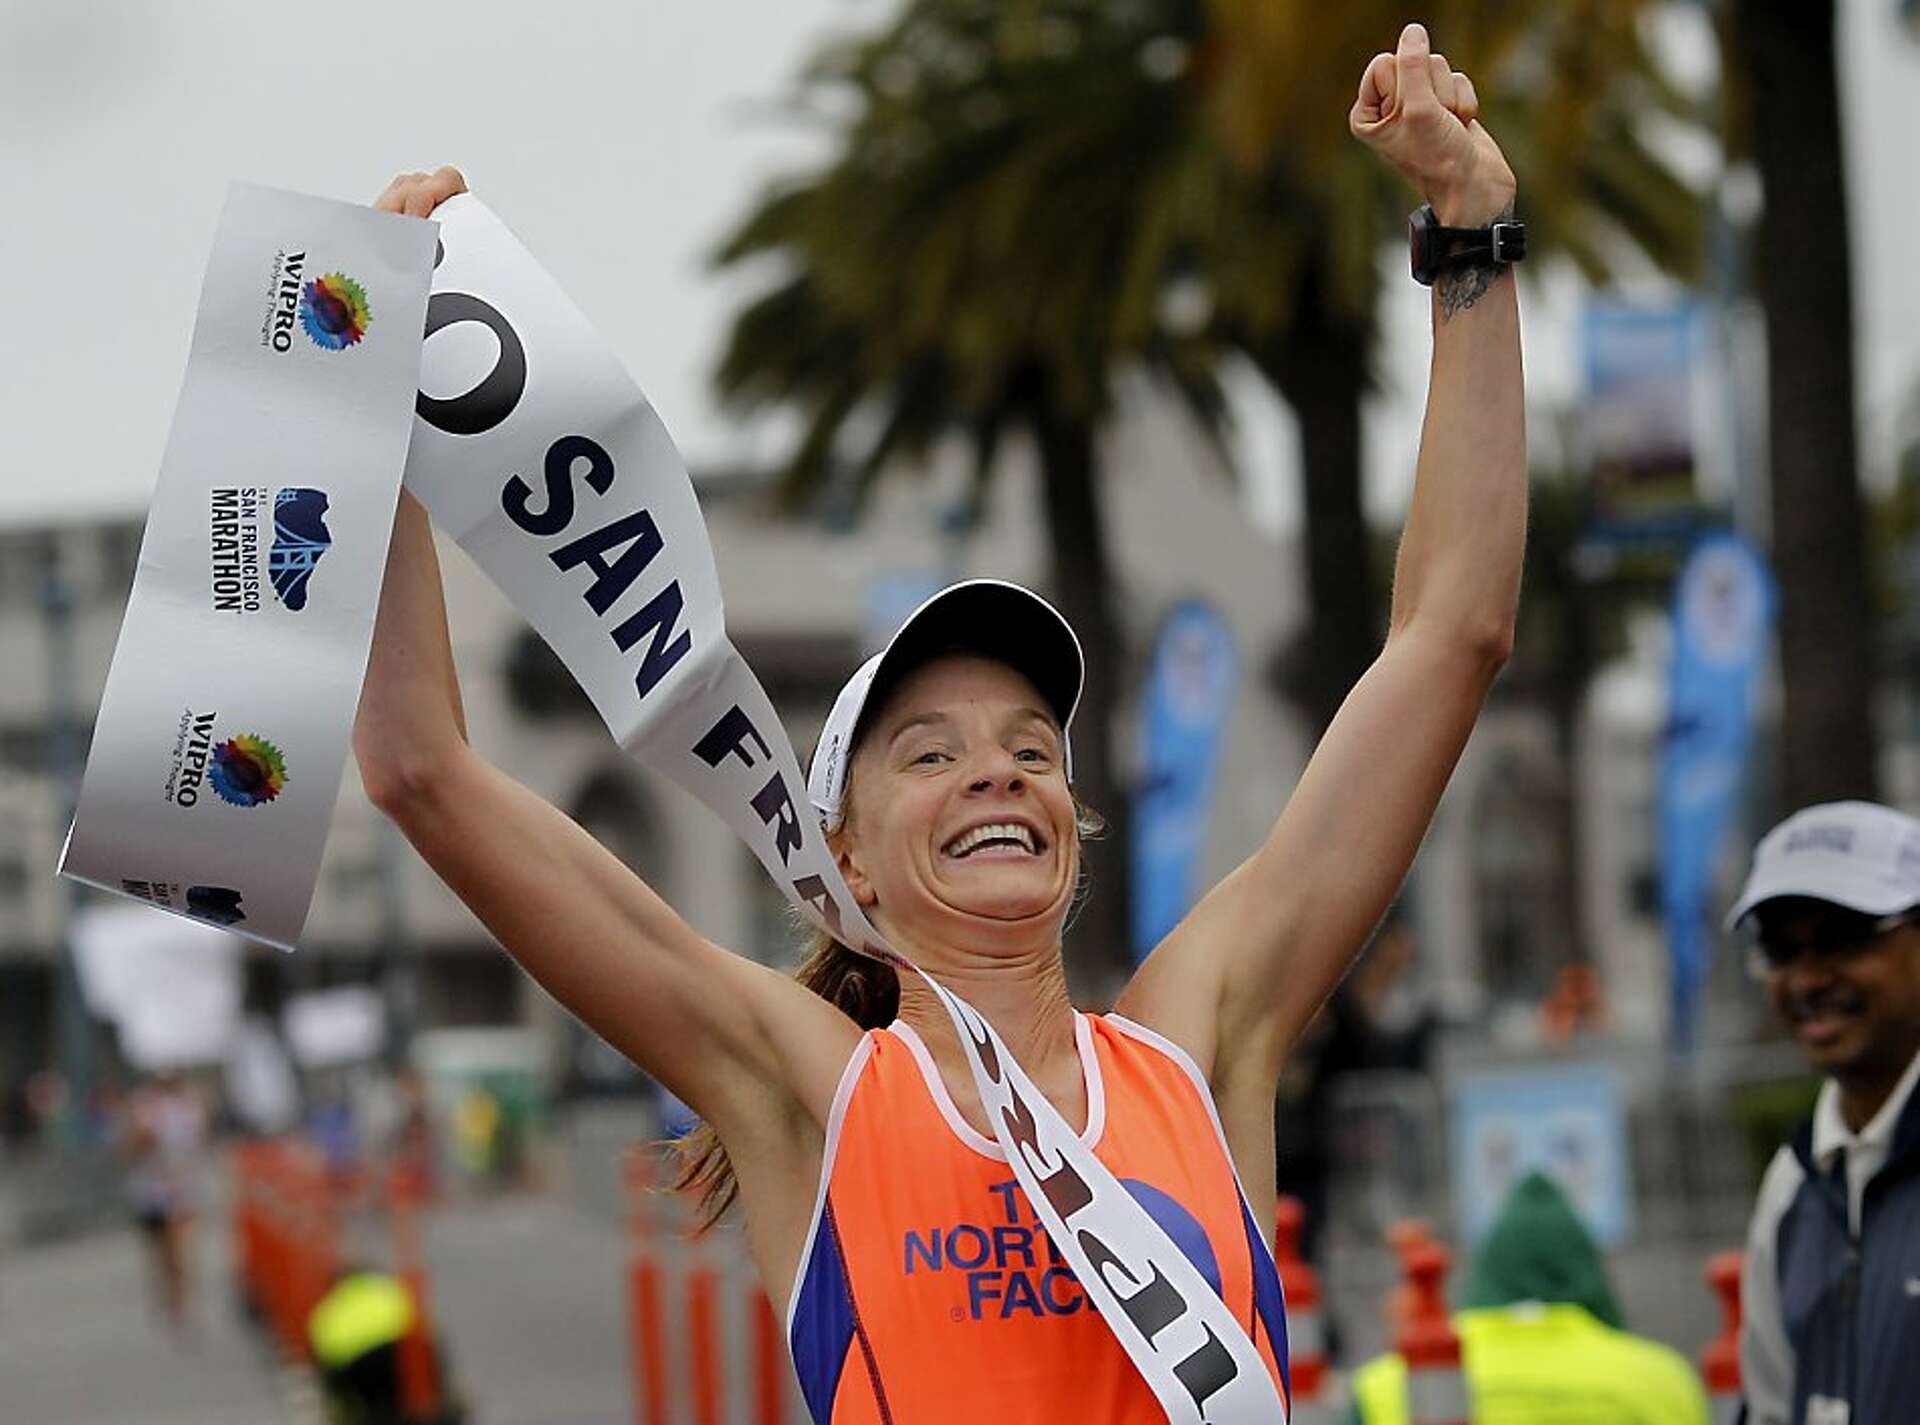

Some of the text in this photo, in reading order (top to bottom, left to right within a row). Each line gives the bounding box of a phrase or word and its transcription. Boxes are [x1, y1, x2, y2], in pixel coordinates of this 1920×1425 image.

[273, 252, 306, 352] WIPRO
[212, 489, 242, 612] MARATHON
[241, 487, 260, 611] SAN FRANCISCO
[416, 238, 846, 938] O SAN FRA
[178, 711, 217, 808] WIPRO
[904, 1224, 1062, 1274] NORT
[967, 1267, 1098, 1320] FAC
